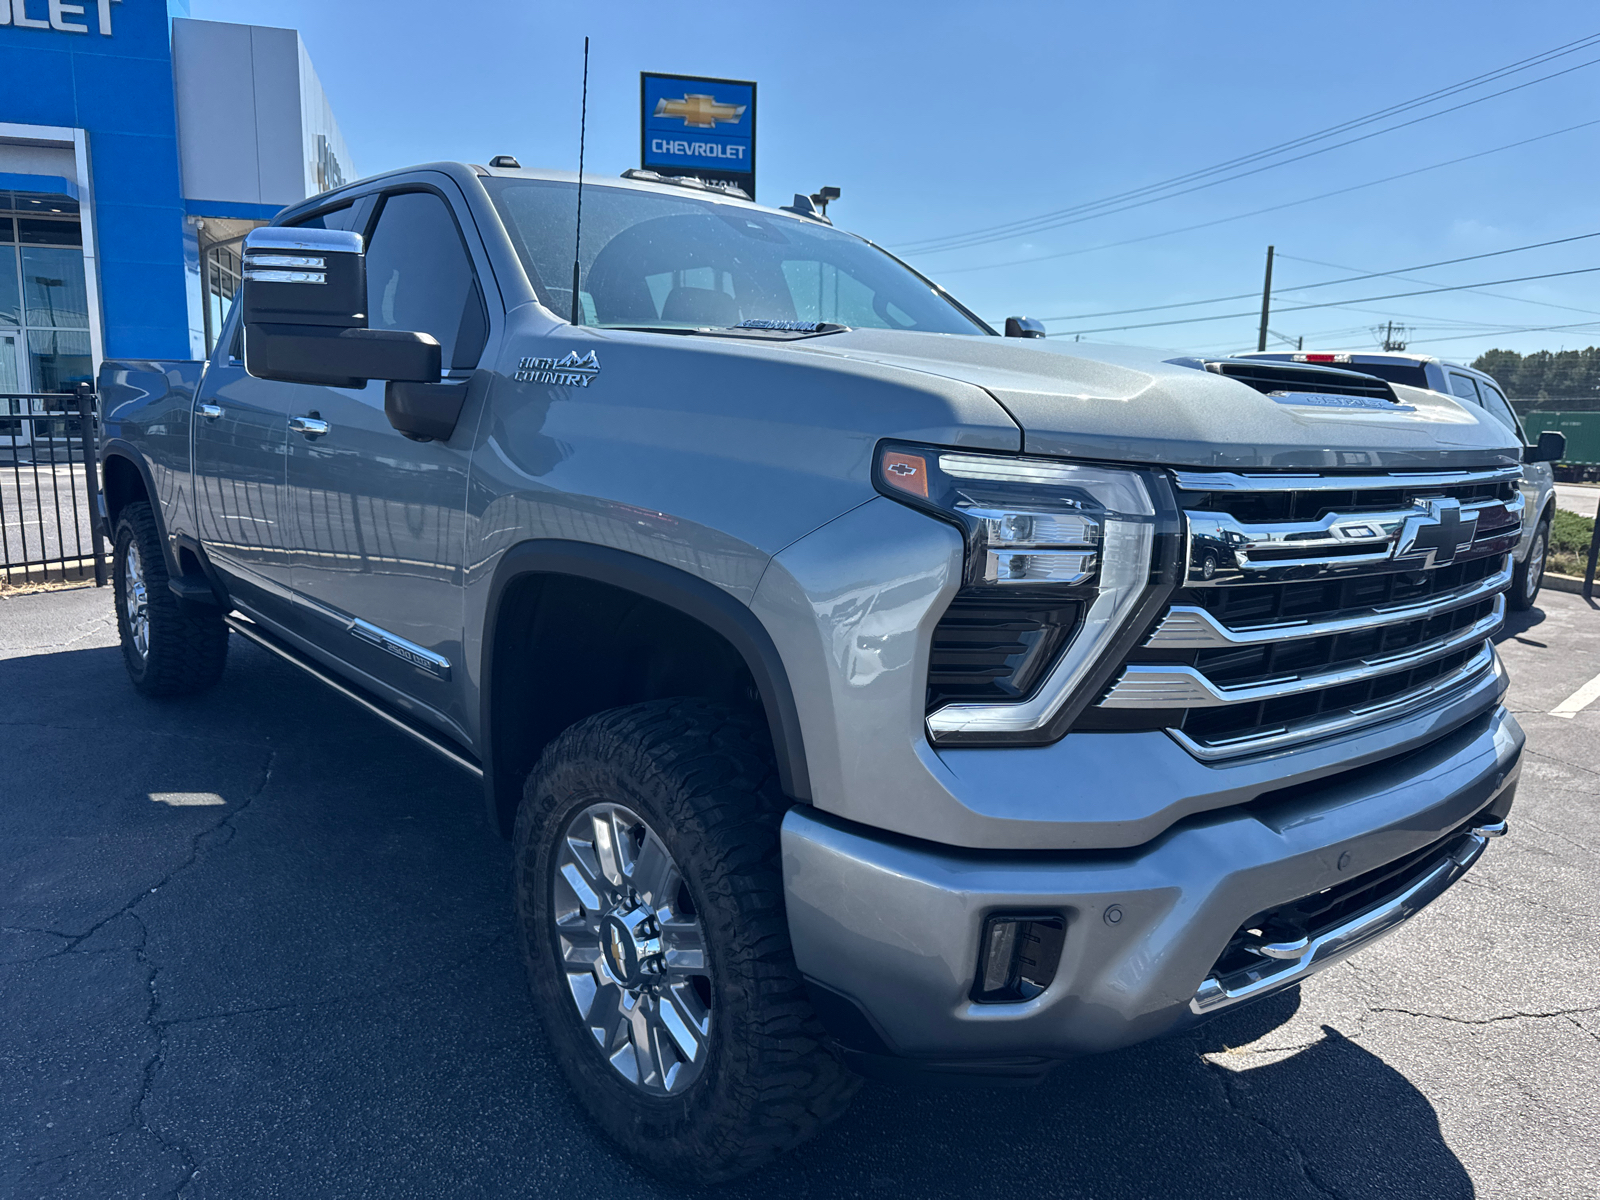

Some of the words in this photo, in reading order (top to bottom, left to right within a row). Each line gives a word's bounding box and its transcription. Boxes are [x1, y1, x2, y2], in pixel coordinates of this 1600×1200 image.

[651, 139, 746, 160] CHEVROLET
[518, 356, 559, 370] HIGH
[513, 370, 597, 388] COUNTRY
